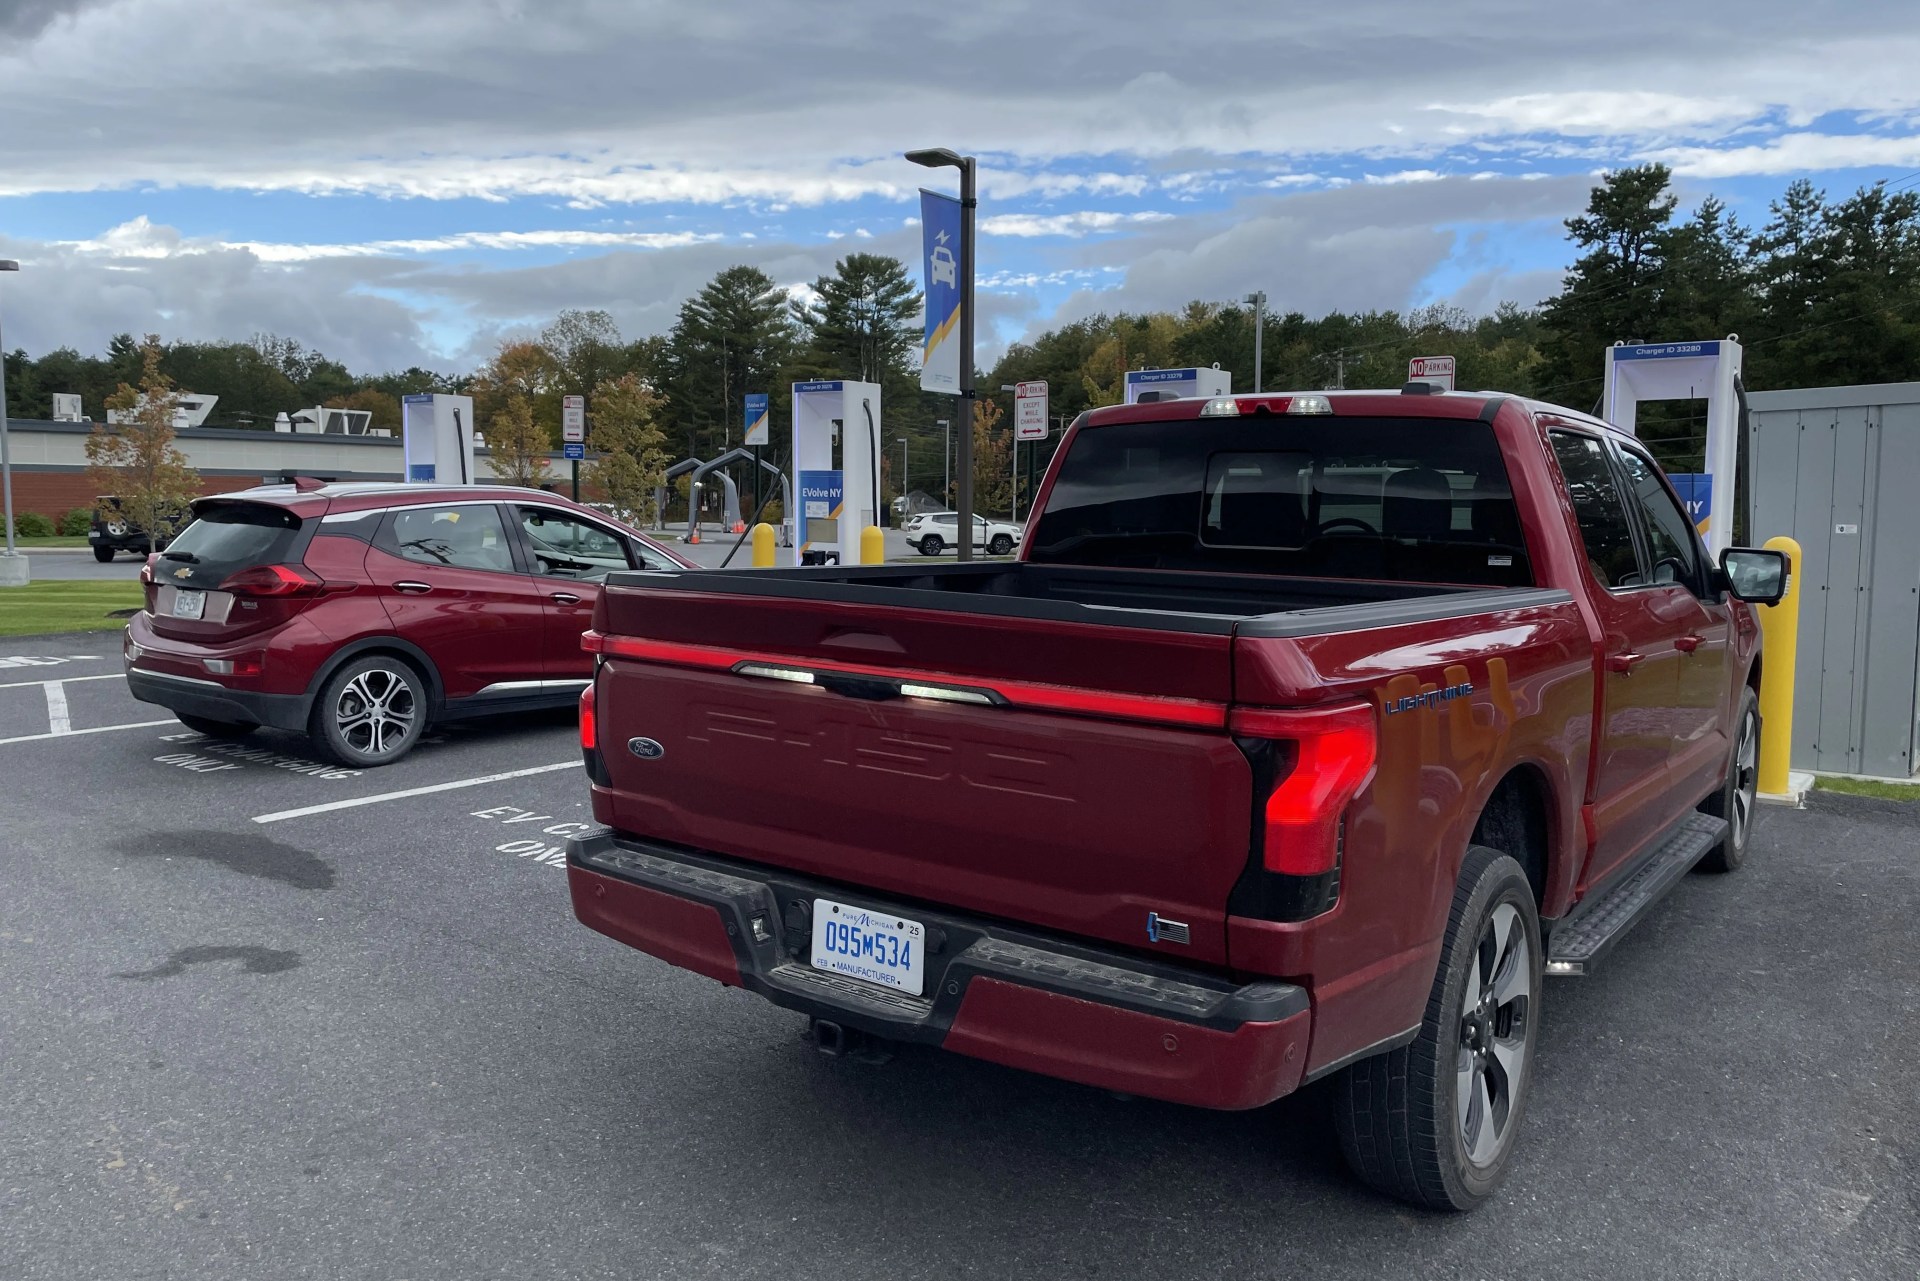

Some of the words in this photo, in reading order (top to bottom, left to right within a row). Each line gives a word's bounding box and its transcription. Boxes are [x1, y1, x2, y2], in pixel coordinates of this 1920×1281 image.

[1411, 361, 1424, 375] NO
[1424, 362, 1452, 372] PARKING
[1016, 385, 1026, 397] NO
[1026, 386, 1046, 394] PARKING
[802, 488, 829, 498] EVolve
[829, 488, 842, 498] NY
[1385, 683, 1474, 715] LIGHTNING
[153, 753, 245, 773] ONLY
[469, 806, 554, 823] EV
[842, 913, 857, 921] PURE
[854, 913, 895, 930] MICHIGAN
[825, 921, 911, 972] 095M534
[817, 958, 828, 967] FEB
[836, 961, 896, 985] MANUFACTURER
